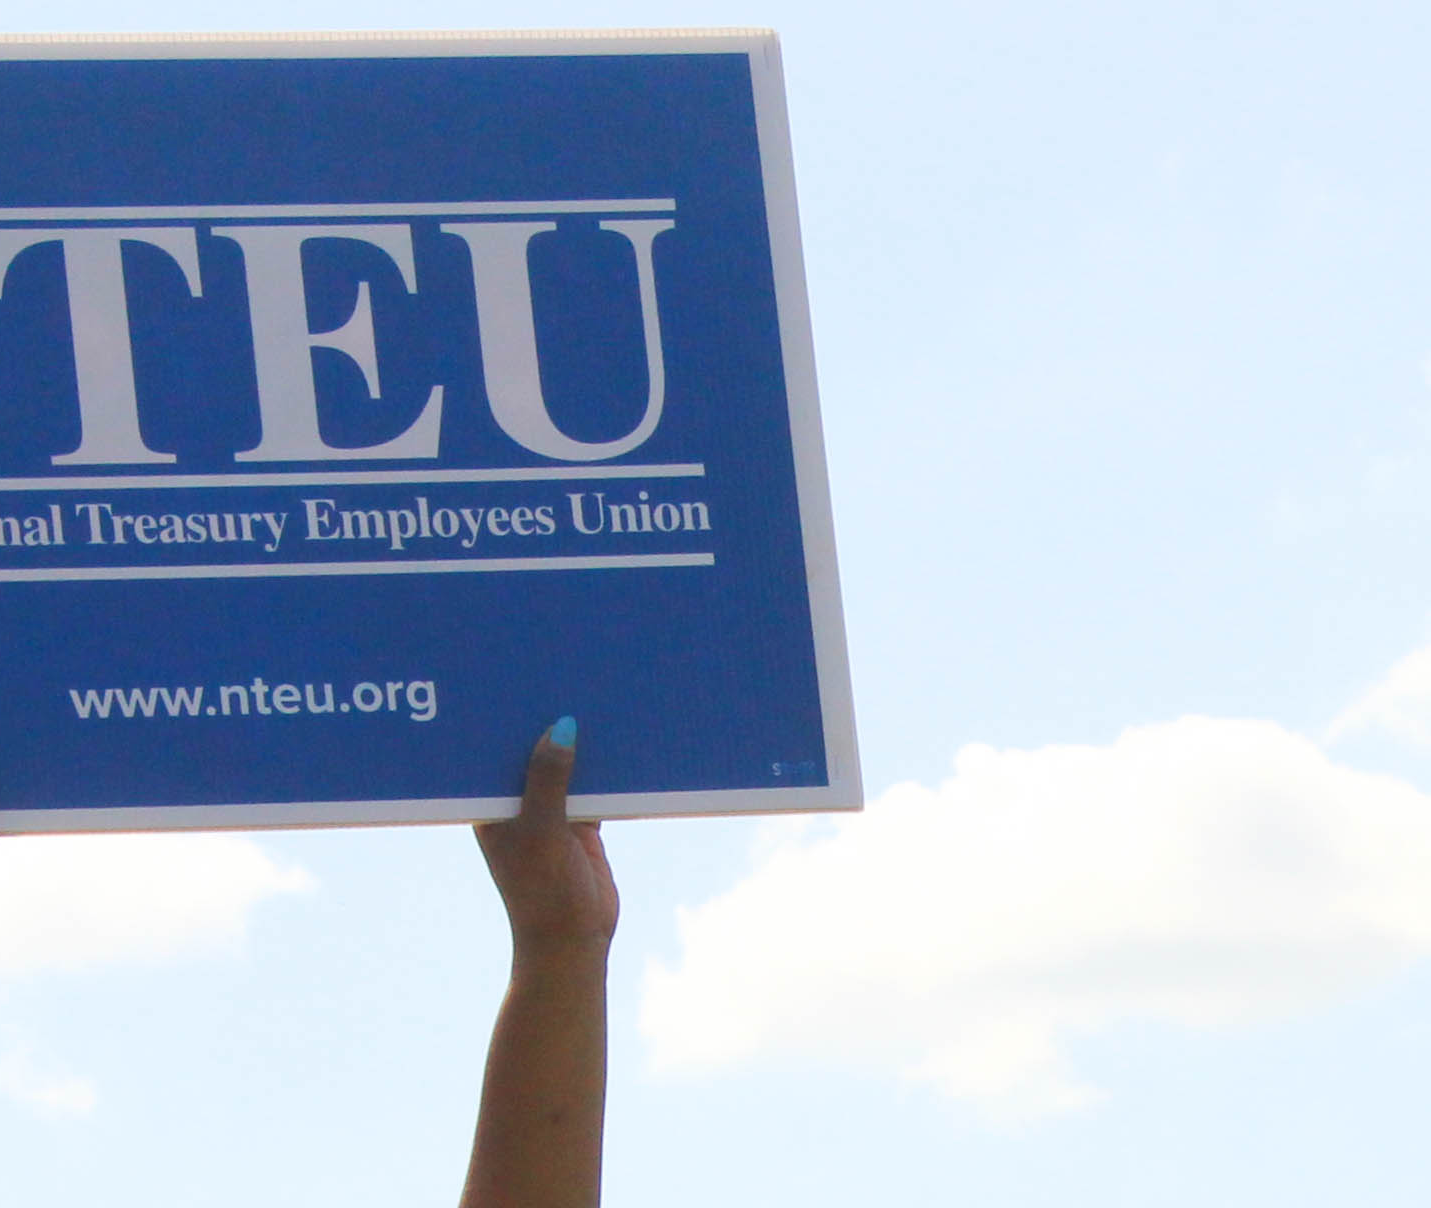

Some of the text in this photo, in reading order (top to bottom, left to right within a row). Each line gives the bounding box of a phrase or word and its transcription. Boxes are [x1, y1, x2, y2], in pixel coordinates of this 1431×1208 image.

[75, 502, 288, 553] Treasury
[300, 496, 557, 551] Employees
[565, 490, 712, 536] Union
[68, 674, 439, 722] www.nteu.org
